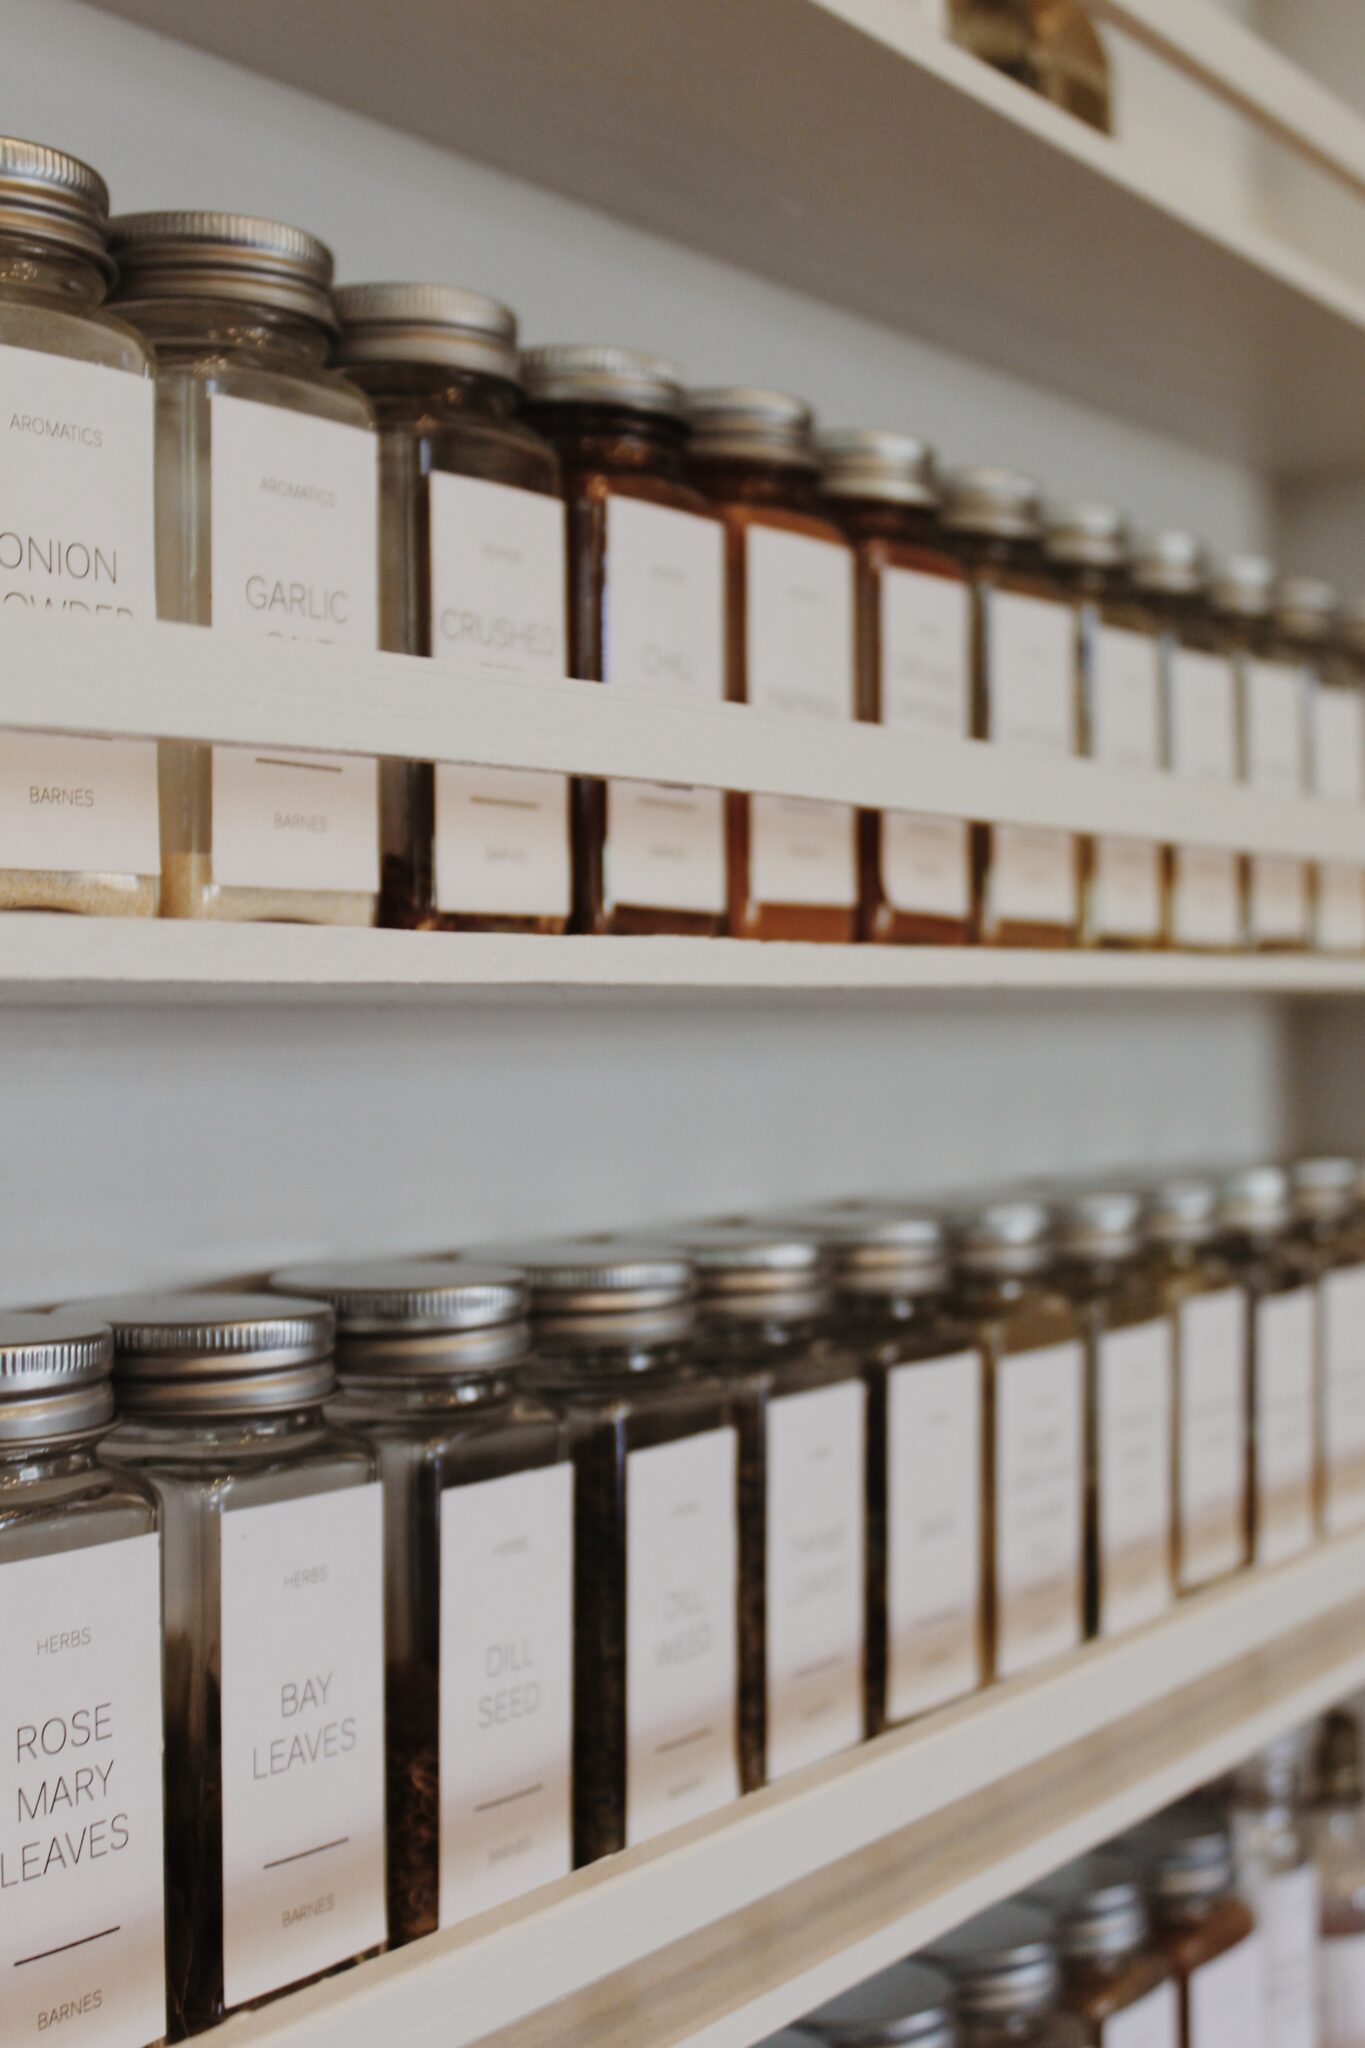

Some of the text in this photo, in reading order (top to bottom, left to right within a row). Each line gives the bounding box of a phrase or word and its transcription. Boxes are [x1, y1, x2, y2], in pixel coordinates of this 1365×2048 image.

[9, 413, 104, 447] AROMATICS
[0, 531, 117, 584] ONION
[245, 574, 350, 625] GARLIC
[29, 785, 95, 808] BARNES
[281, 1564, 329, 1590] HERBS
[35, 1626, 93, 1657] HERBS
[280, 1671, 335, 1719] BAY
[476, 1679, 542, 1731] SEED
[15, 1702, 114, 1764] ROSE
[252, 1716, 358, 1781] LEAVES
[16, 1759, 116, 1824] MARY
[0, 1812, 130, 1890] LEAVES
[281, 1893, 335, 1930] BARNES
[37, 1989, 104, 2032] BARNES
